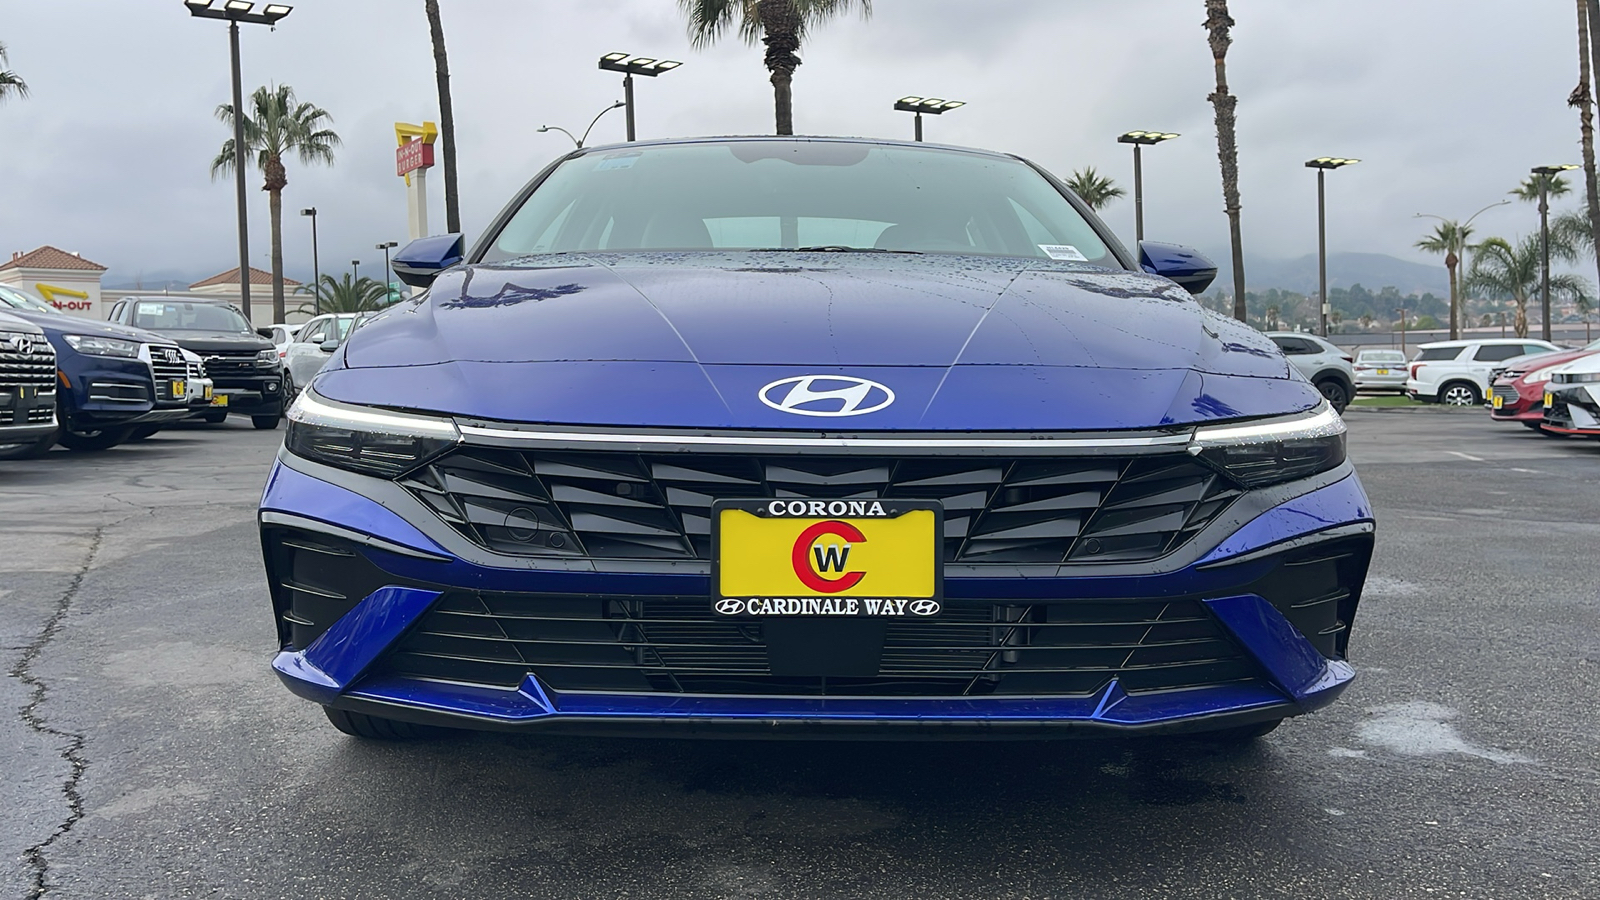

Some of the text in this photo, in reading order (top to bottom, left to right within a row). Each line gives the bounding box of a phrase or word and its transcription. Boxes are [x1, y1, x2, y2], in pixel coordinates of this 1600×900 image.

[398, 141, 421, 160] IN-N-OUT
[398, 153, 421, 173] BURGER
[768, 501, 887, 516] CORONA
[747, 599, 908, 615] CARDINALE WAY
